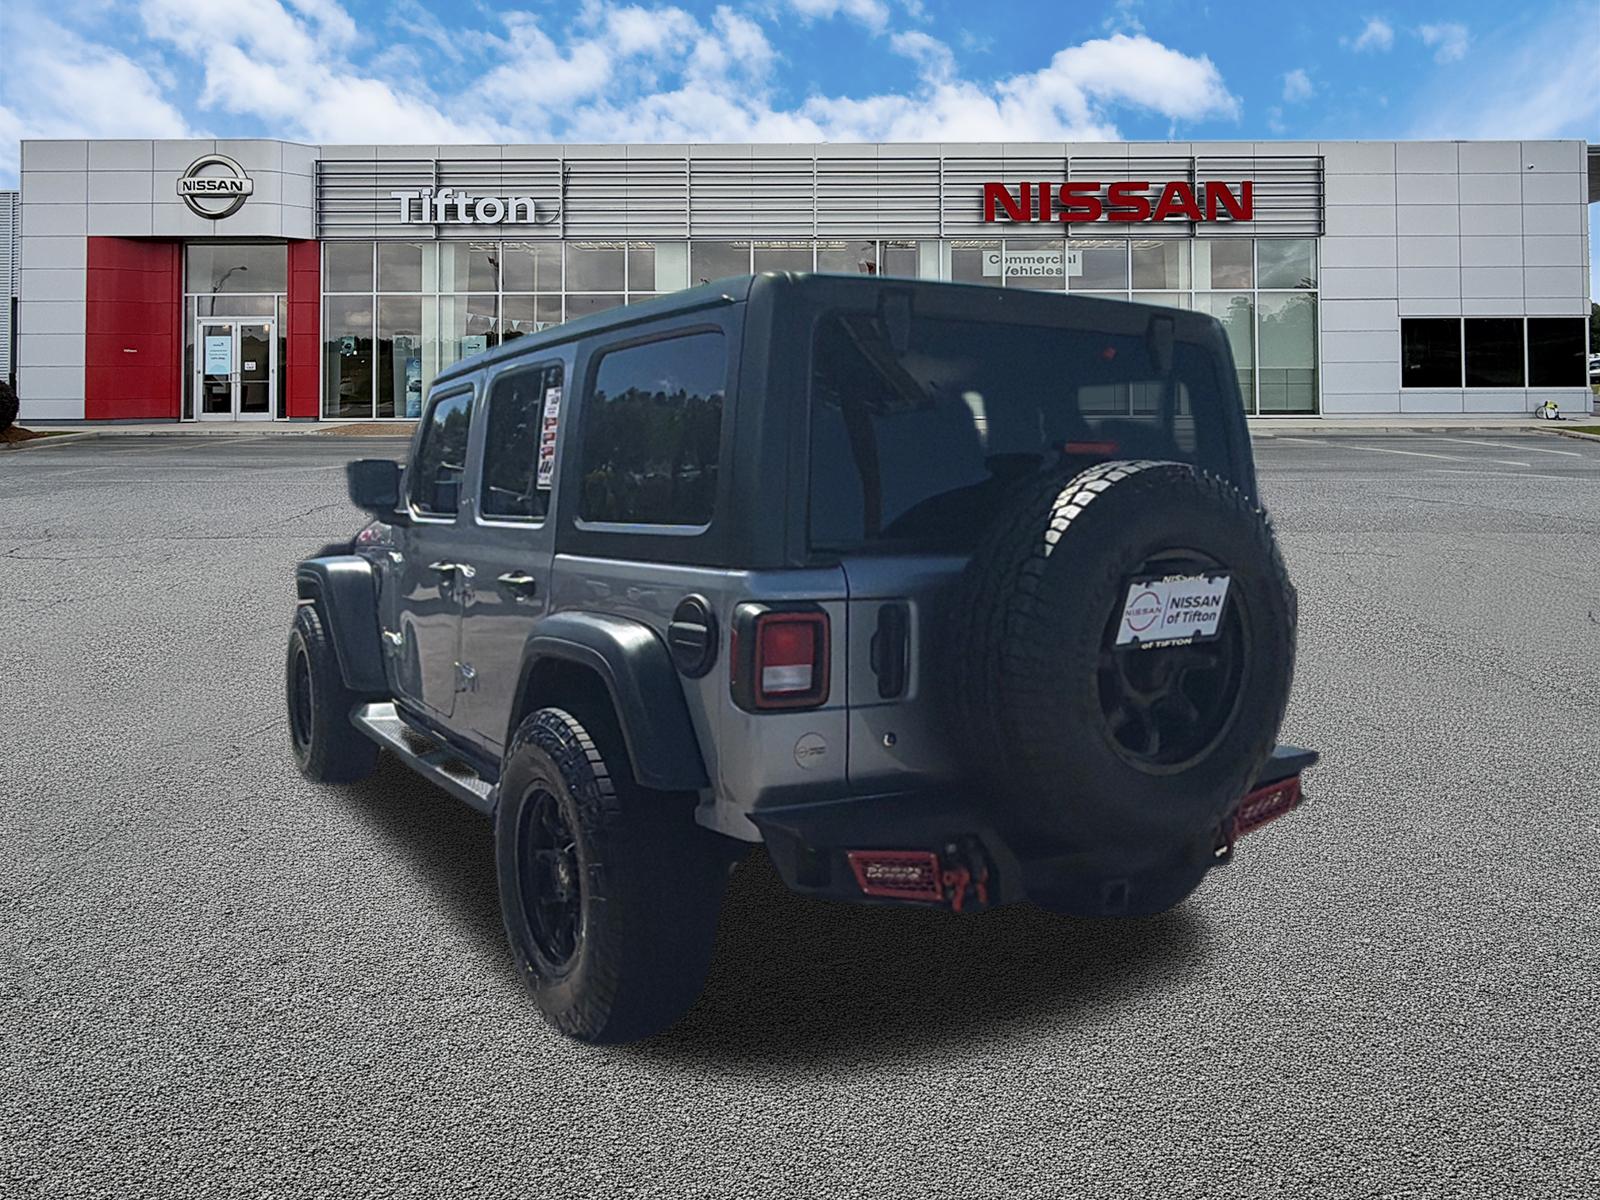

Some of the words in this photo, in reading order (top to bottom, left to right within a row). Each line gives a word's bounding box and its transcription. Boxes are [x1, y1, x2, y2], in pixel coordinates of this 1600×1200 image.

[183, 180, 243, 191] NISSAN
[388, 187, 537, 224] Tifton
[983, 181, 1253, 222] NISSAN
[1169, 596, 1221, 609] NISSAN
[1126, 607, 1162, 616] NISSAN
[1167, 611, 1180, 624] of
[1182, 611, 1217, 622] Tifton
